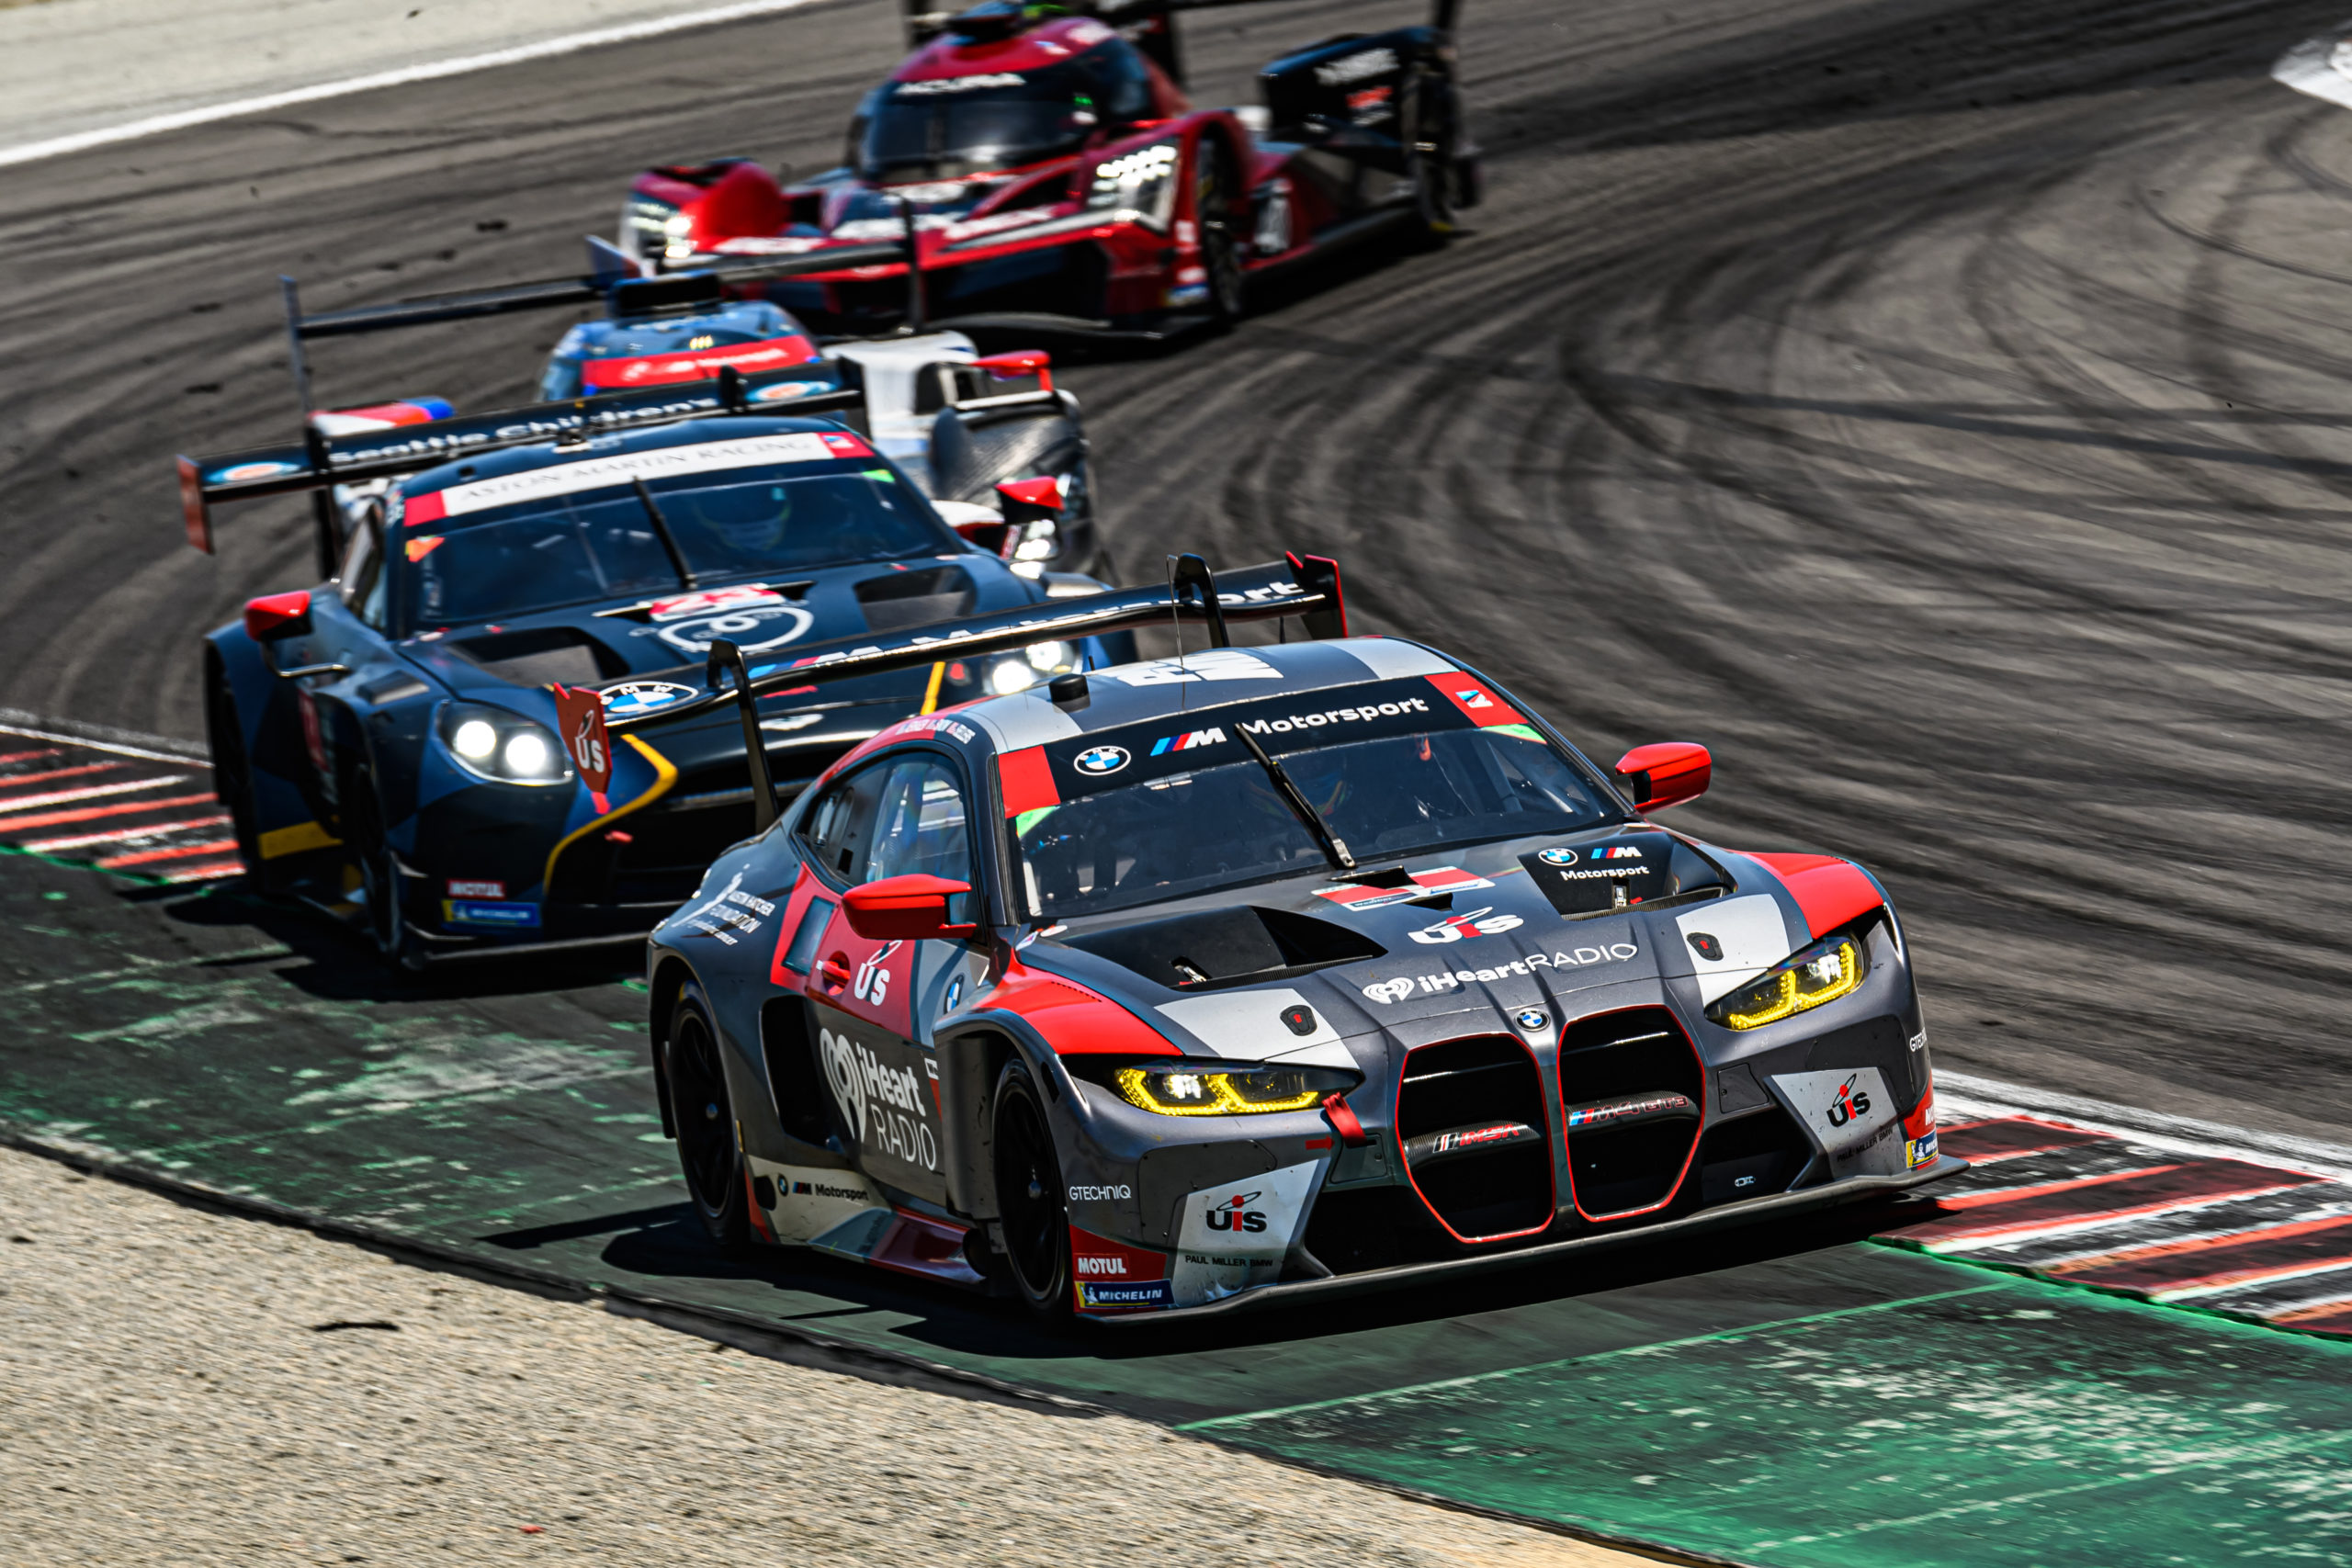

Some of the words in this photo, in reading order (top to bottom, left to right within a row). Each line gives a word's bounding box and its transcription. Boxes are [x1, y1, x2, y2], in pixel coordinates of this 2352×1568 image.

[573, 453, 687, 479] MARTIN
[697, 438, 814, 461] RACING
[1241, 697, 1430, 735] Motorsport
[1559, 865, 1650, 881] Motorsport
[855, 1042, 927, 1118] iHeart
[870, 1103, 937, 1171] RADIO
[815, 1183, 870, 1201] Motorsport
[1069, 1184, 1132, 1201] GTECHNIQ
[1078, 1257, 1126, 1275] MOTUL
[1185, 1255, 1209, 1265] PAUL
[1212, 1257, 1247, 1267] MILLER
[1250, 1258, 1274, 1268] BMW
[1098, 1288, 1163, 1301] MICHELIN
